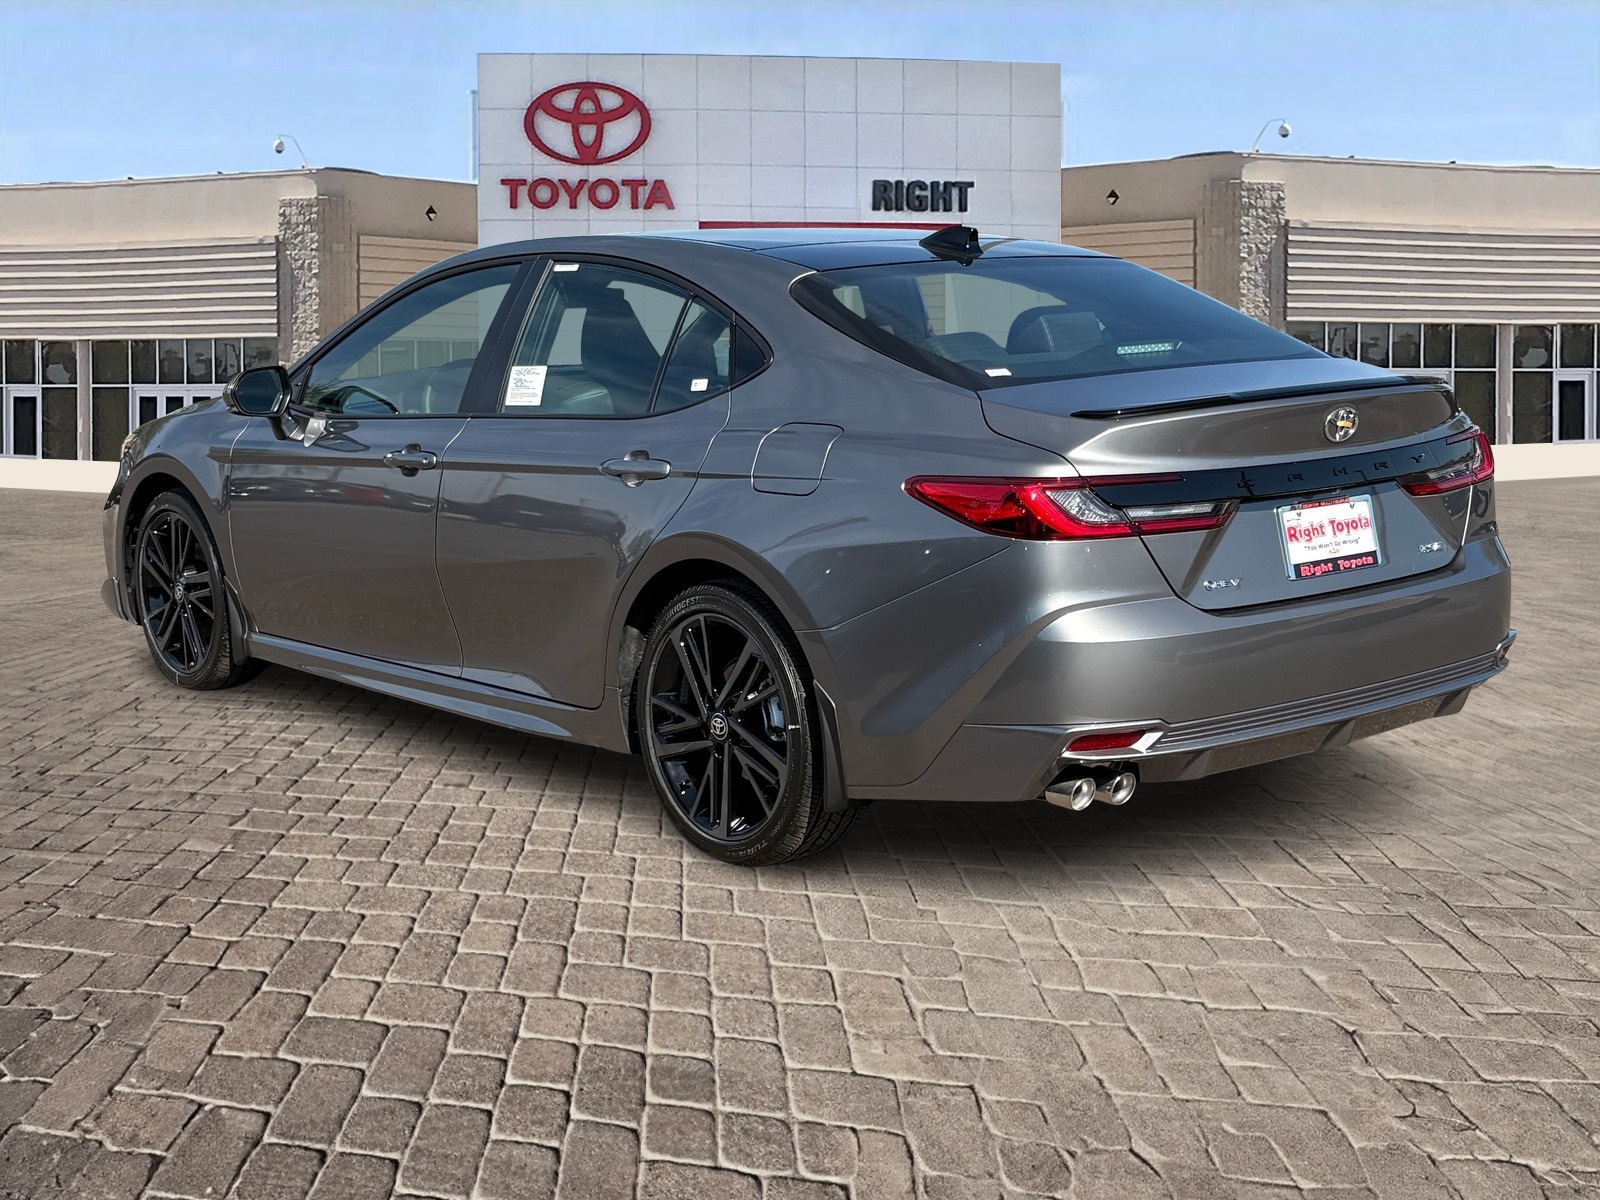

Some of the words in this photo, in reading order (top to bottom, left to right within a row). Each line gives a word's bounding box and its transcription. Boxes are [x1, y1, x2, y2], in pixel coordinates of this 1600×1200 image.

[500, 177, 675, 210] TOYOTA
[872, 179, 975, 213] RIGHT
[1287, 523, 1325, 542] Right
[1329, 516, 1370, 536] Toyota
[1300, 563, 1333, 576] Right
[1338, 556, 1374, 570] Toyota
